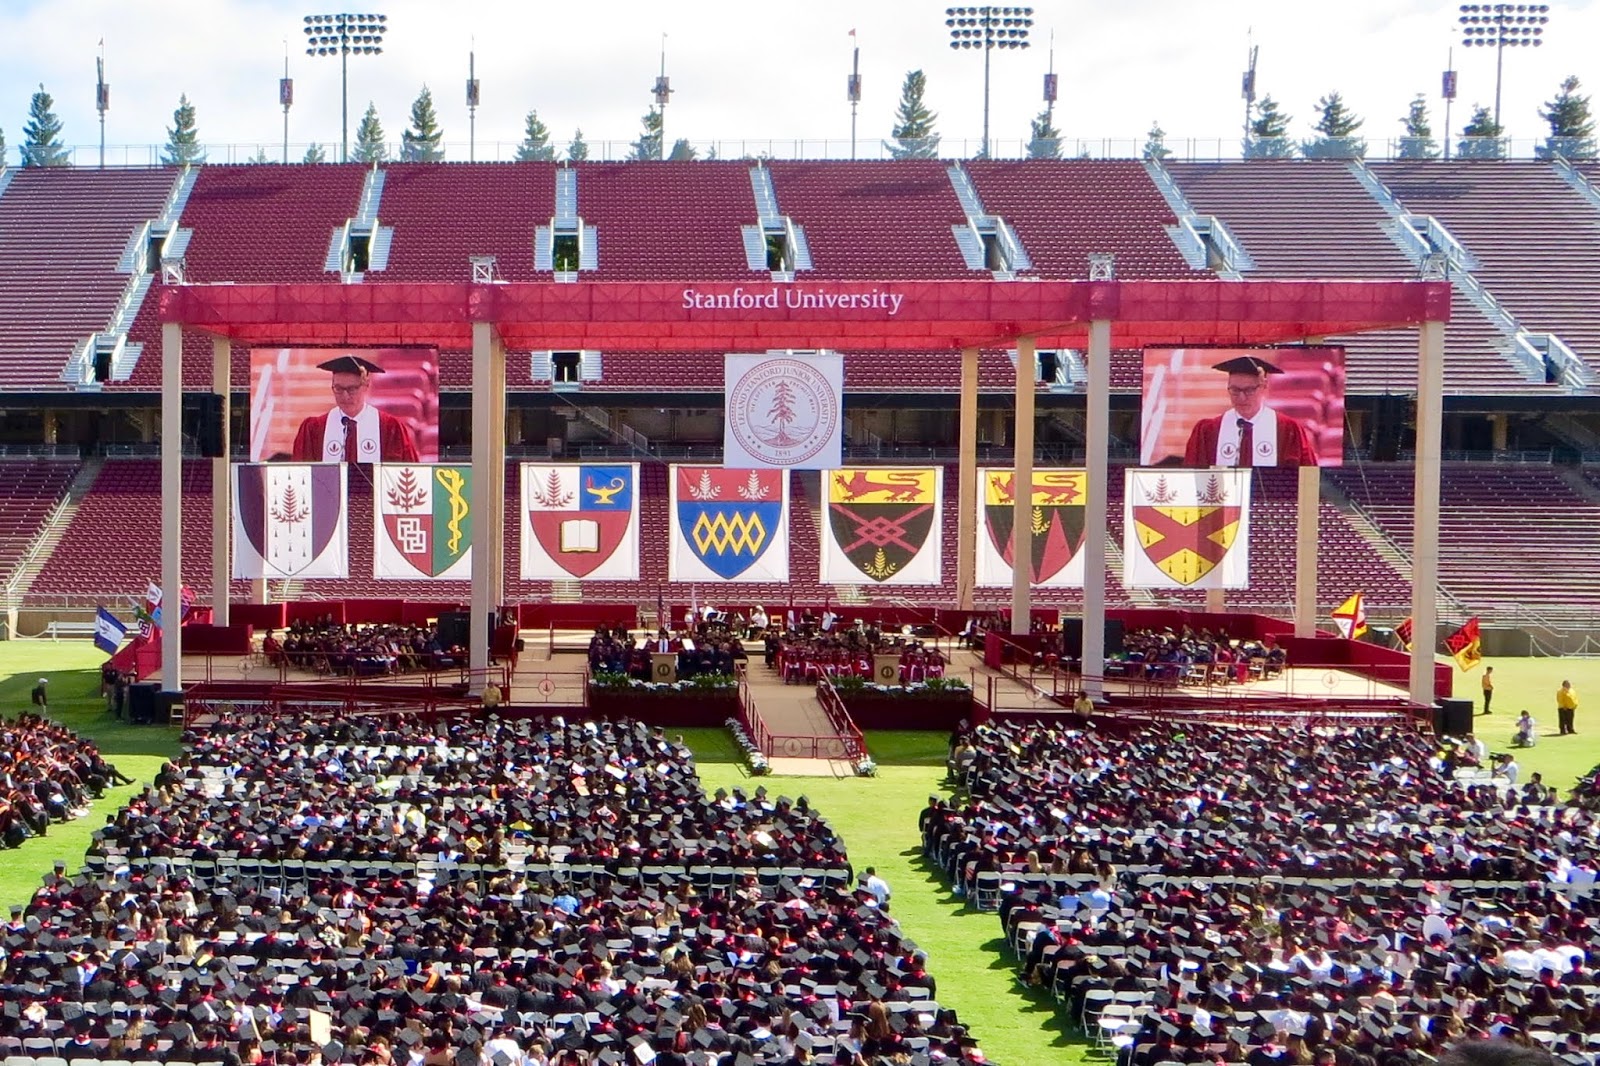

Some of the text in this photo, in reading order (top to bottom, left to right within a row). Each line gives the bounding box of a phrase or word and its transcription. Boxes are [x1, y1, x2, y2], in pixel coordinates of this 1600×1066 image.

[682, 289, 904, 315] Stanford University
[738, 393, 748, 426] LELAND
[744, 367, 782, 391] STANFORD
[783, 366, 812, 382] JUNIOR
[811, 379, 829, 425] UNIVERSITY
